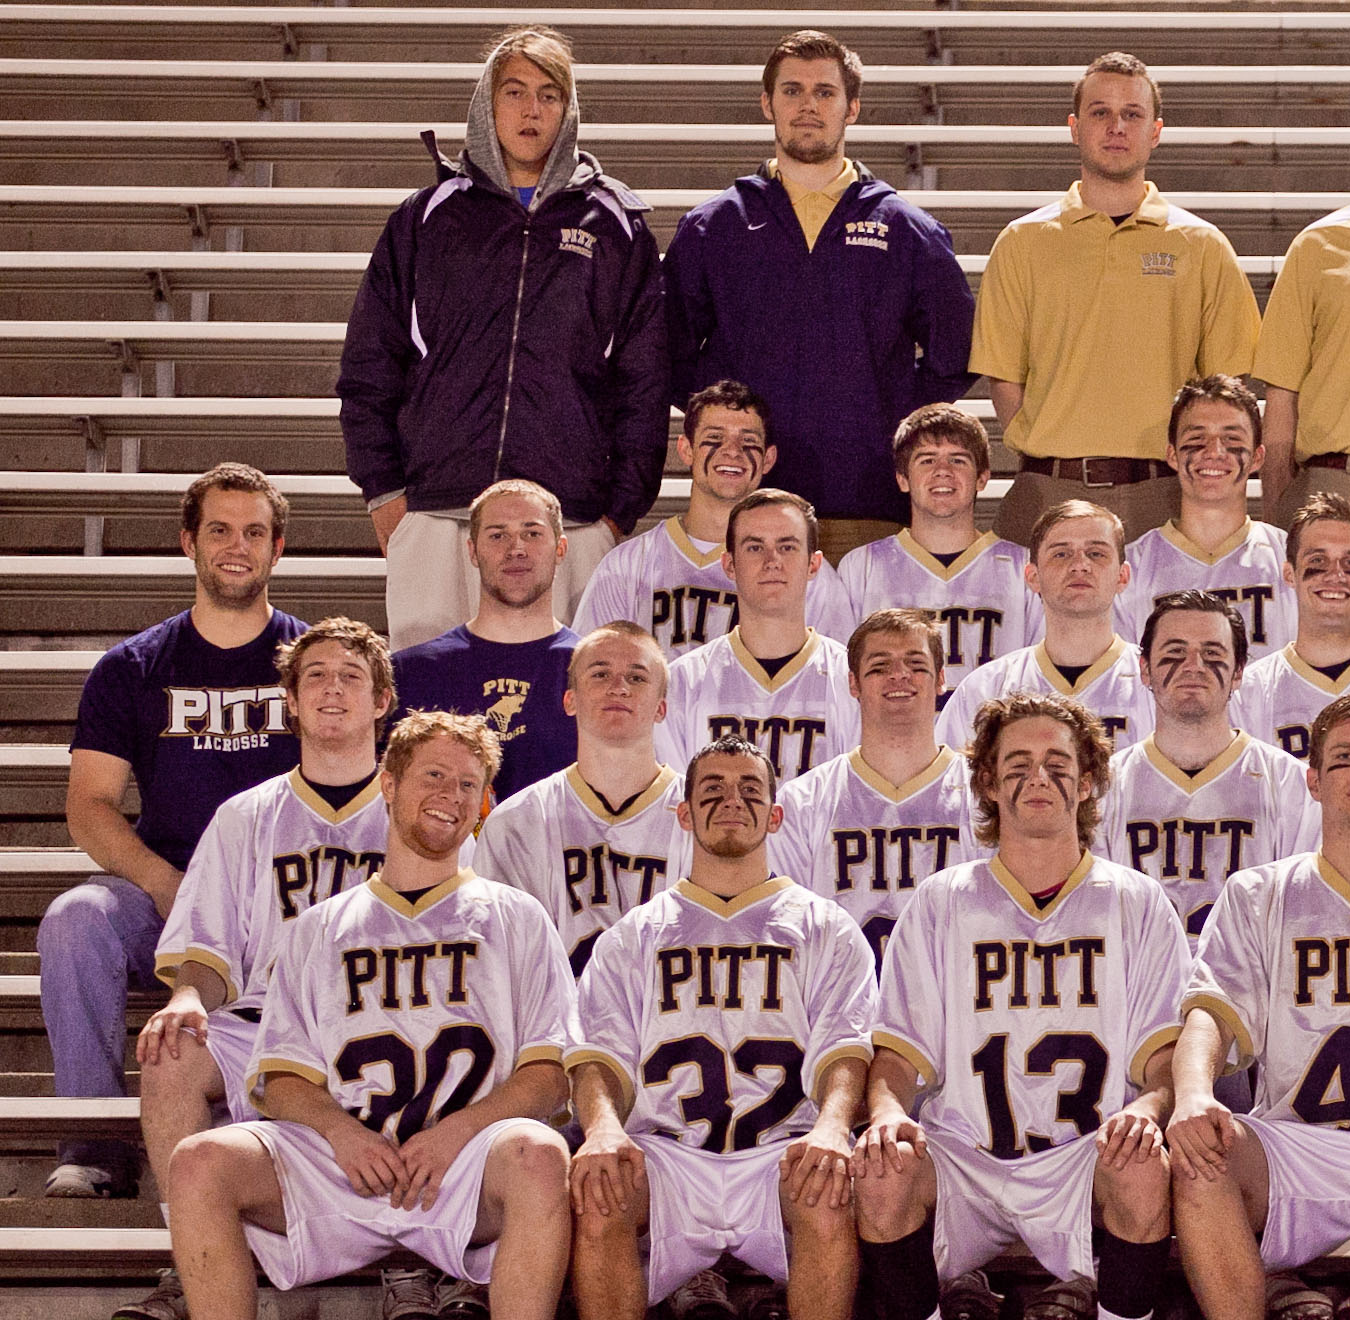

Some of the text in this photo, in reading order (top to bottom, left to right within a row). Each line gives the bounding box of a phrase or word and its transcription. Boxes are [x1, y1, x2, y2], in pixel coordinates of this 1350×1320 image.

[560, 228, 598, 250] PITT
[845, 220, 889, 238] PITT
[924, 605, 1004, 667] TT
[160, 685, 292, 738] PITT
[483, 678, 531, 697] PITT
[193, 733, 269, 752] LACROSSE
[831, 824, 960, 894] PITT
[1127, 817, 1256, 880] PITT
[342, 941, 479, 1016] PITT
[656, 945, 793, 1014] PITT
[974, 936, 1106, 1012] PITT
[334, 1022, 496, 1142] 30
[641, 1033, 808, 1153] 32
[971, 1031, 1109, 1161] 13
